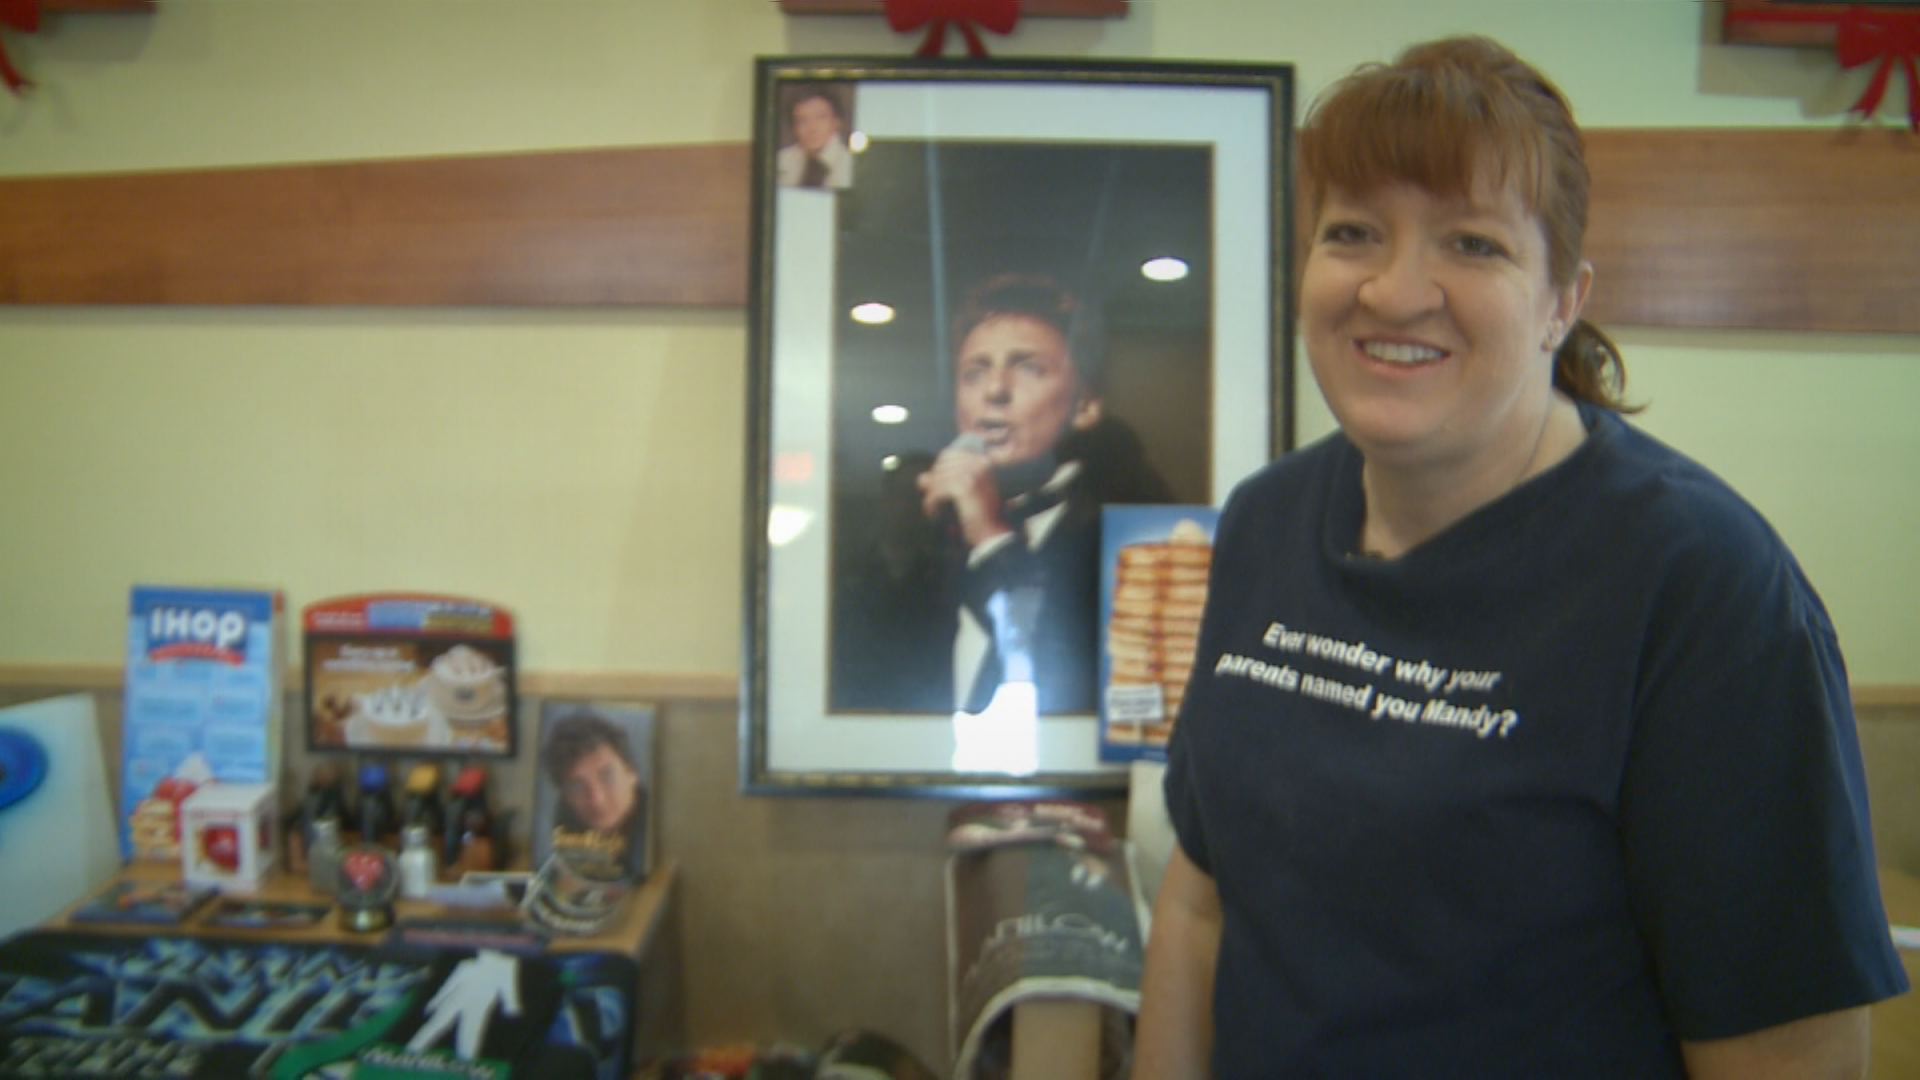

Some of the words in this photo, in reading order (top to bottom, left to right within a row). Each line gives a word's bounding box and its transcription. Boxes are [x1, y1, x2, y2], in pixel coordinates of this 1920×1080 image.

[151, 606, 245, 651] IHOP
[1262, 620, 1305, 652] Ever
[1306, 631, 1392, 675] wonder
[1395, 657, 1448, 692] why
[1444, 669, 1502, 693] your
[1214, 652, 1299, 691] parents
[1300, 672, 1372, 710] named
[1370, 692, 1422, 721] you
[1420, 698, 1518, 738] Mandy?
